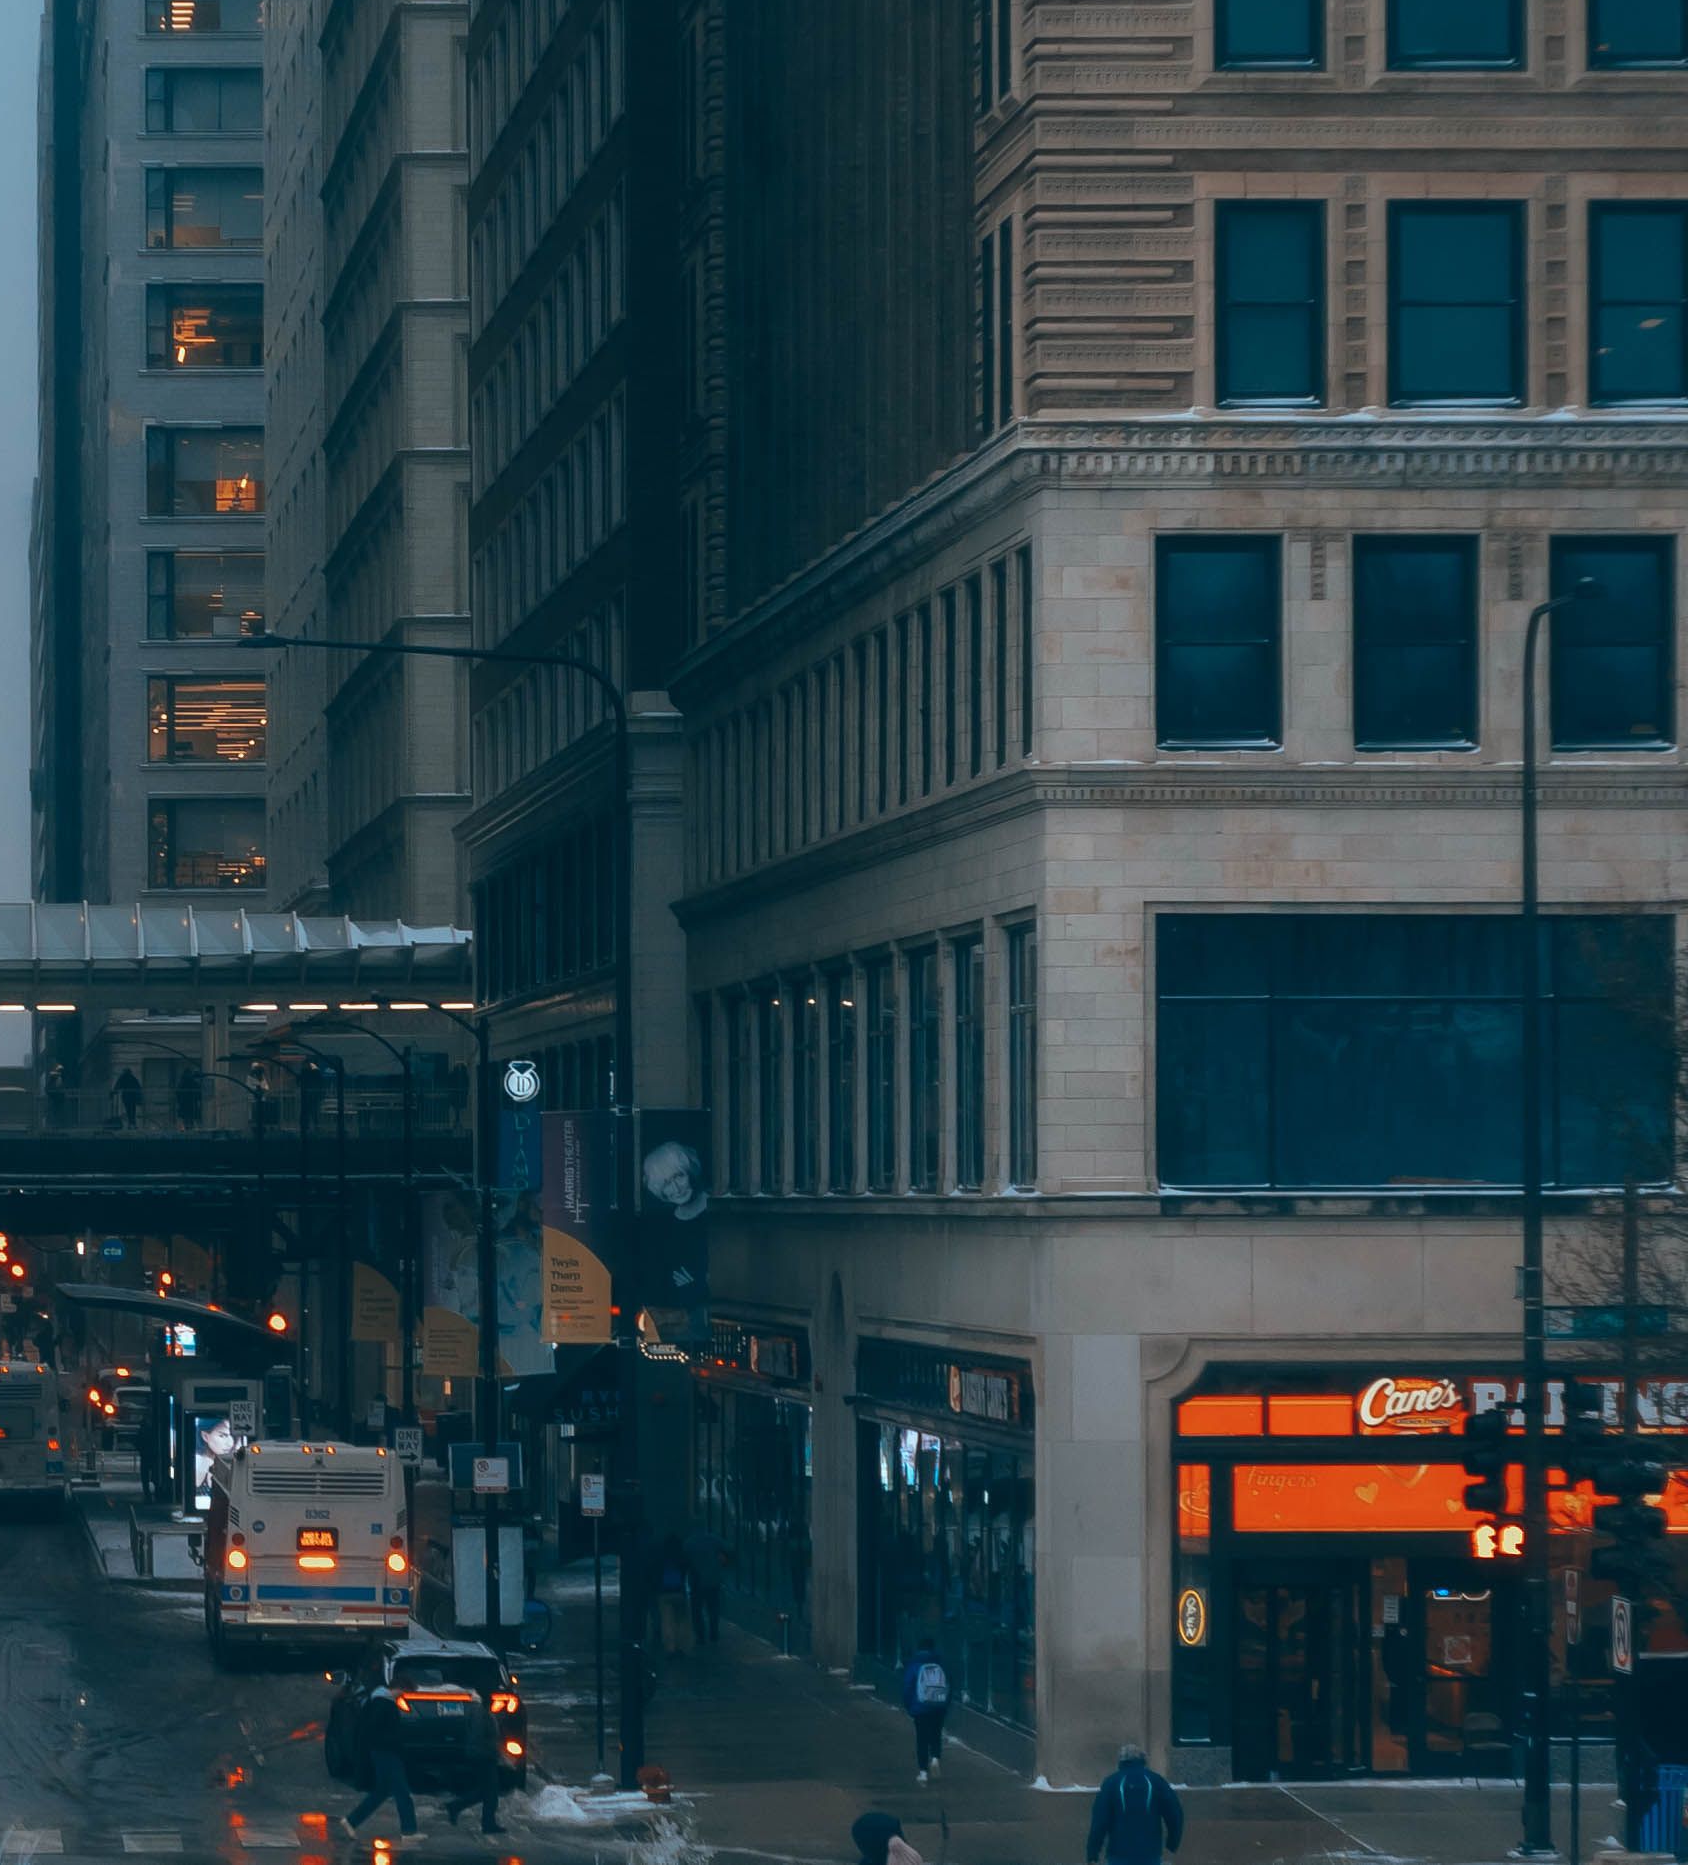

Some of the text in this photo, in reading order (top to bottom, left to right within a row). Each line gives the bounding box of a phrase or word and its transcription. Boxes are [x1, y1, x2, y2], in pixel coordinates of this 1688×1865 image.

[564, 1120, 575, 1209] HARRIS THEATER
[551, 1257, 579, 1269] Twyla
[551, 1270, 581, 1281] Tharp
[551, 1283, 584, 1293] Dance
[1360, 1377, 1462, 1427] Cane's
[1472, 1381, 1688, 1426] RIING
[232, 1403, 253, 1414] ONE
[232, 1414, 253, 1423] WAY
[397, 1430, 419, 1441] ONE
[398, 1441, 419, 1452] WAY
[1185, 1596, 1198, 1639] OPEN
